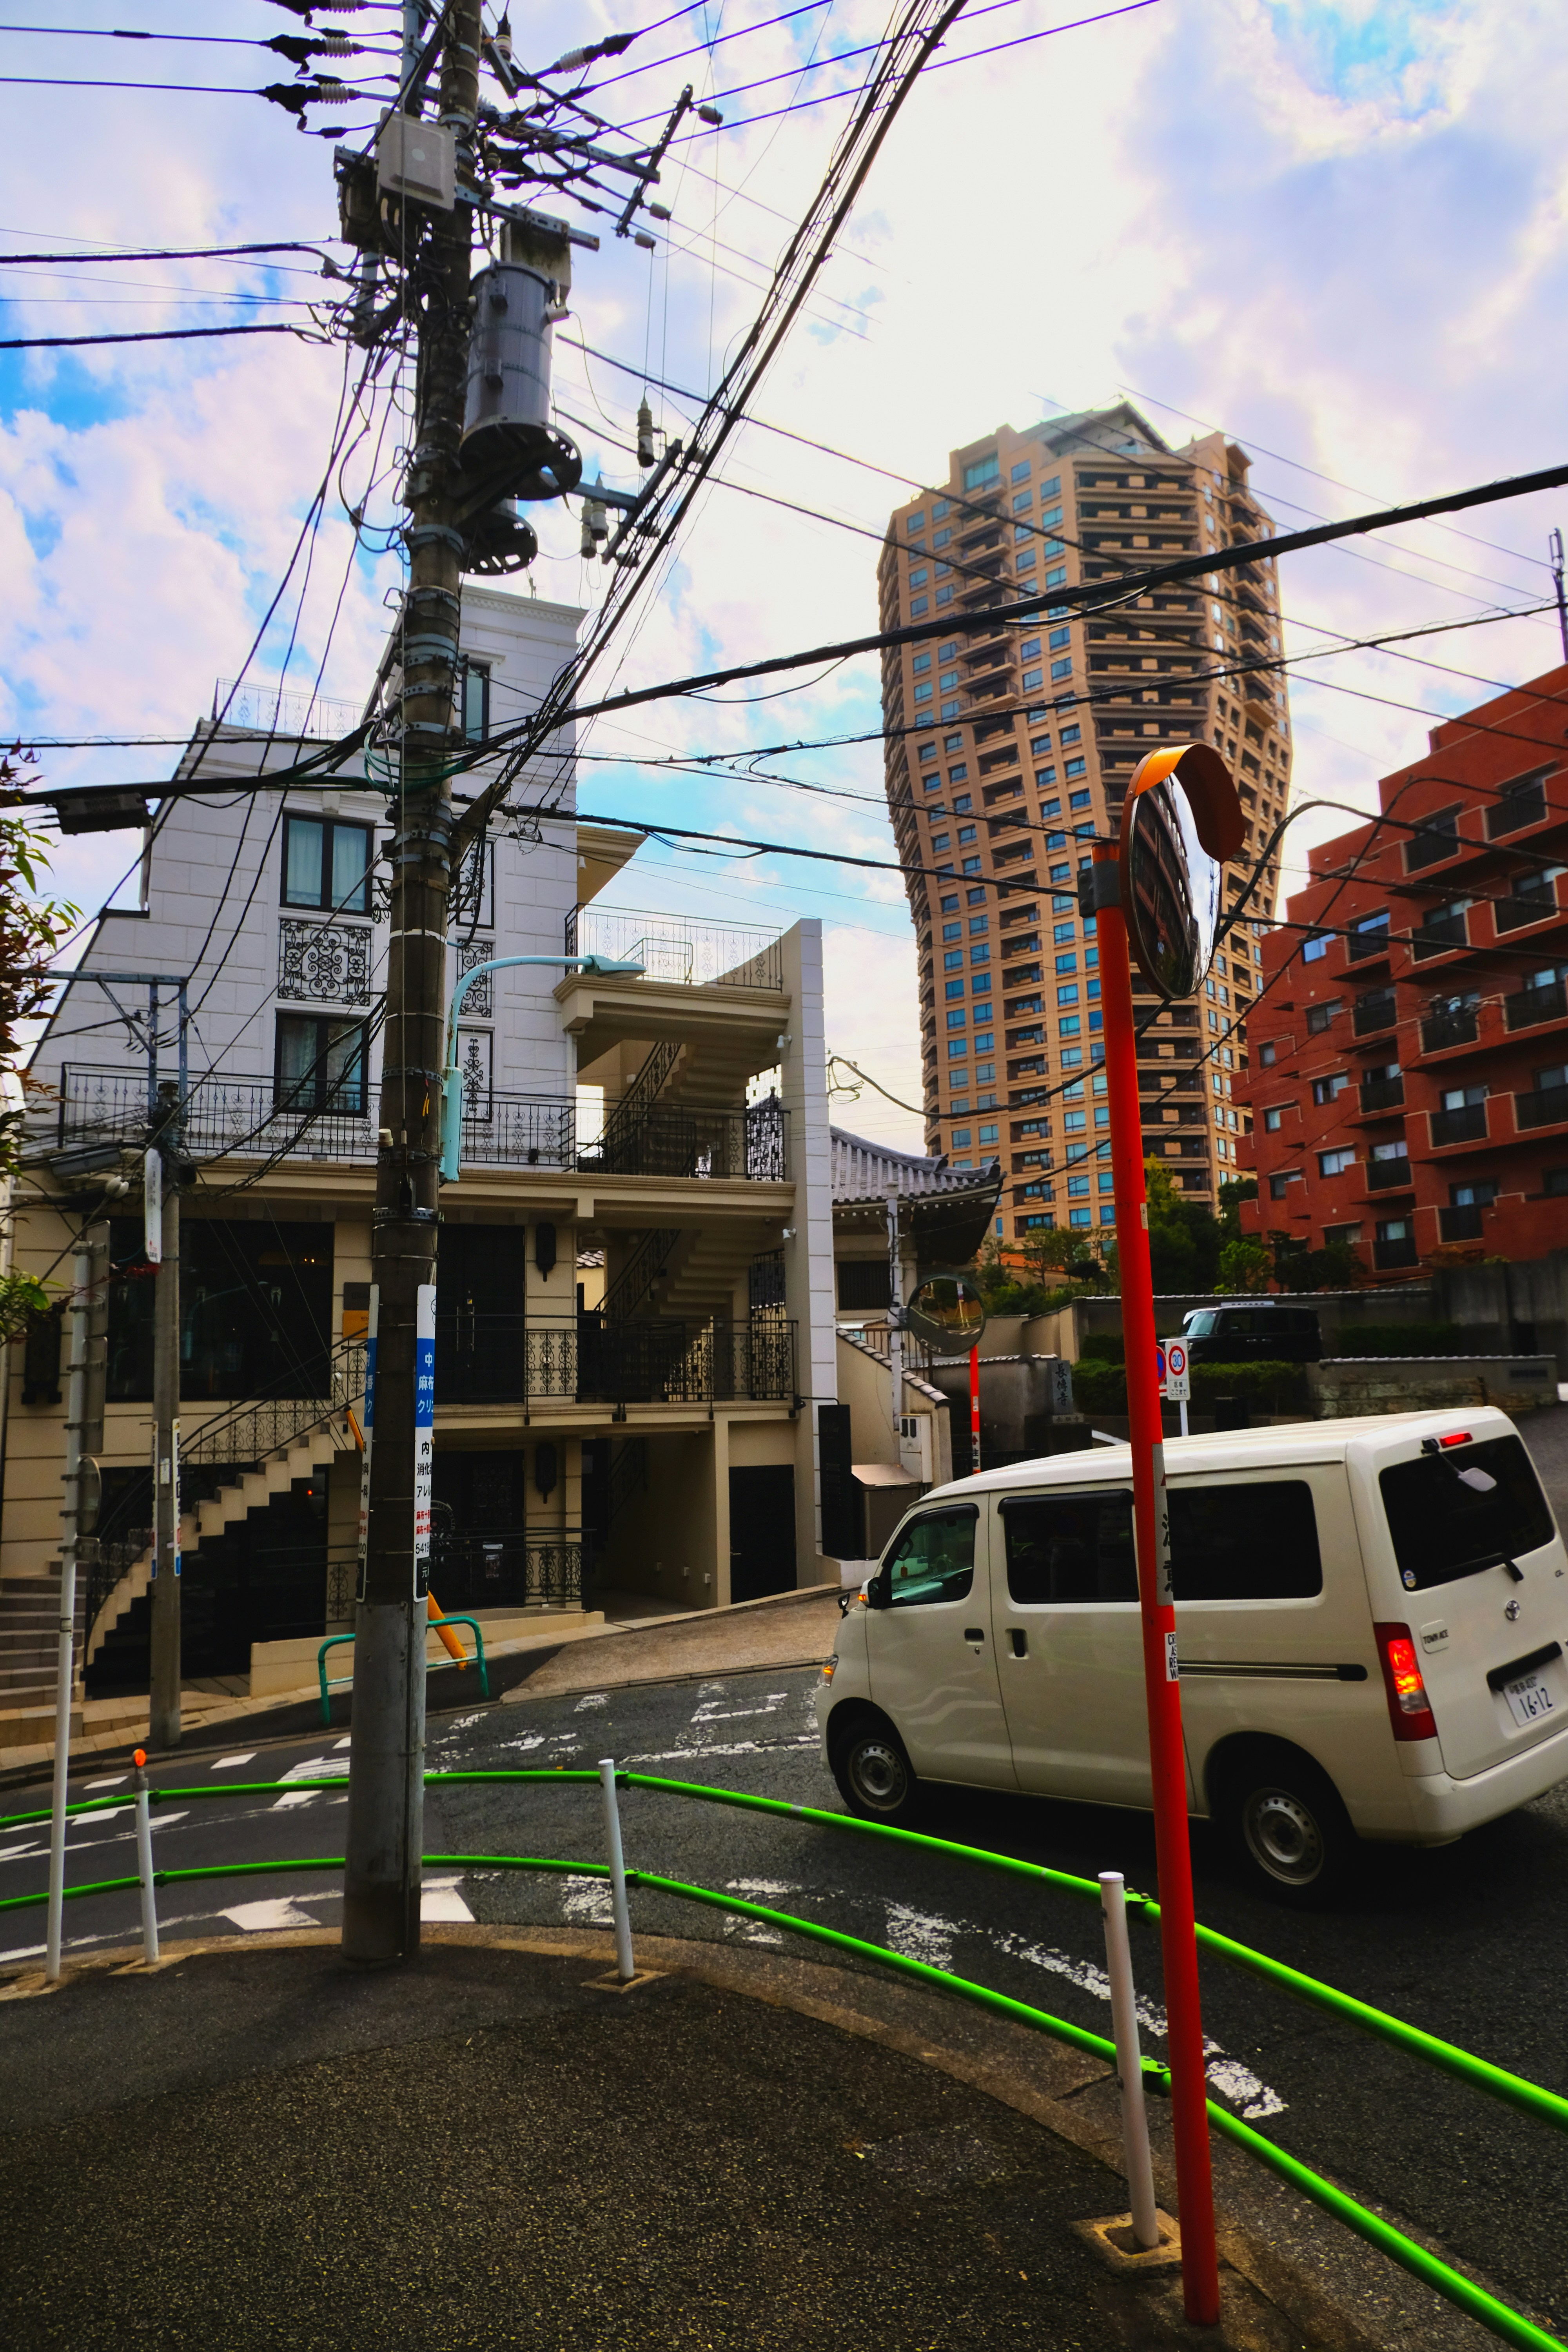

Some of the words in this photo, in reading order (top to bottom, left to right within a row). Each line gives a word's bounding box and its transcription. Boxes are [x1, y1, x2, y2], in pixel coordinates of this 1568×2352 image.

[425, 1352, 433, 1367] 中
[1172, 1354, 1182, 1367] 30
[421, 1441, 429, 1455] 内
[417, 1462, 432, 1476] 消化
